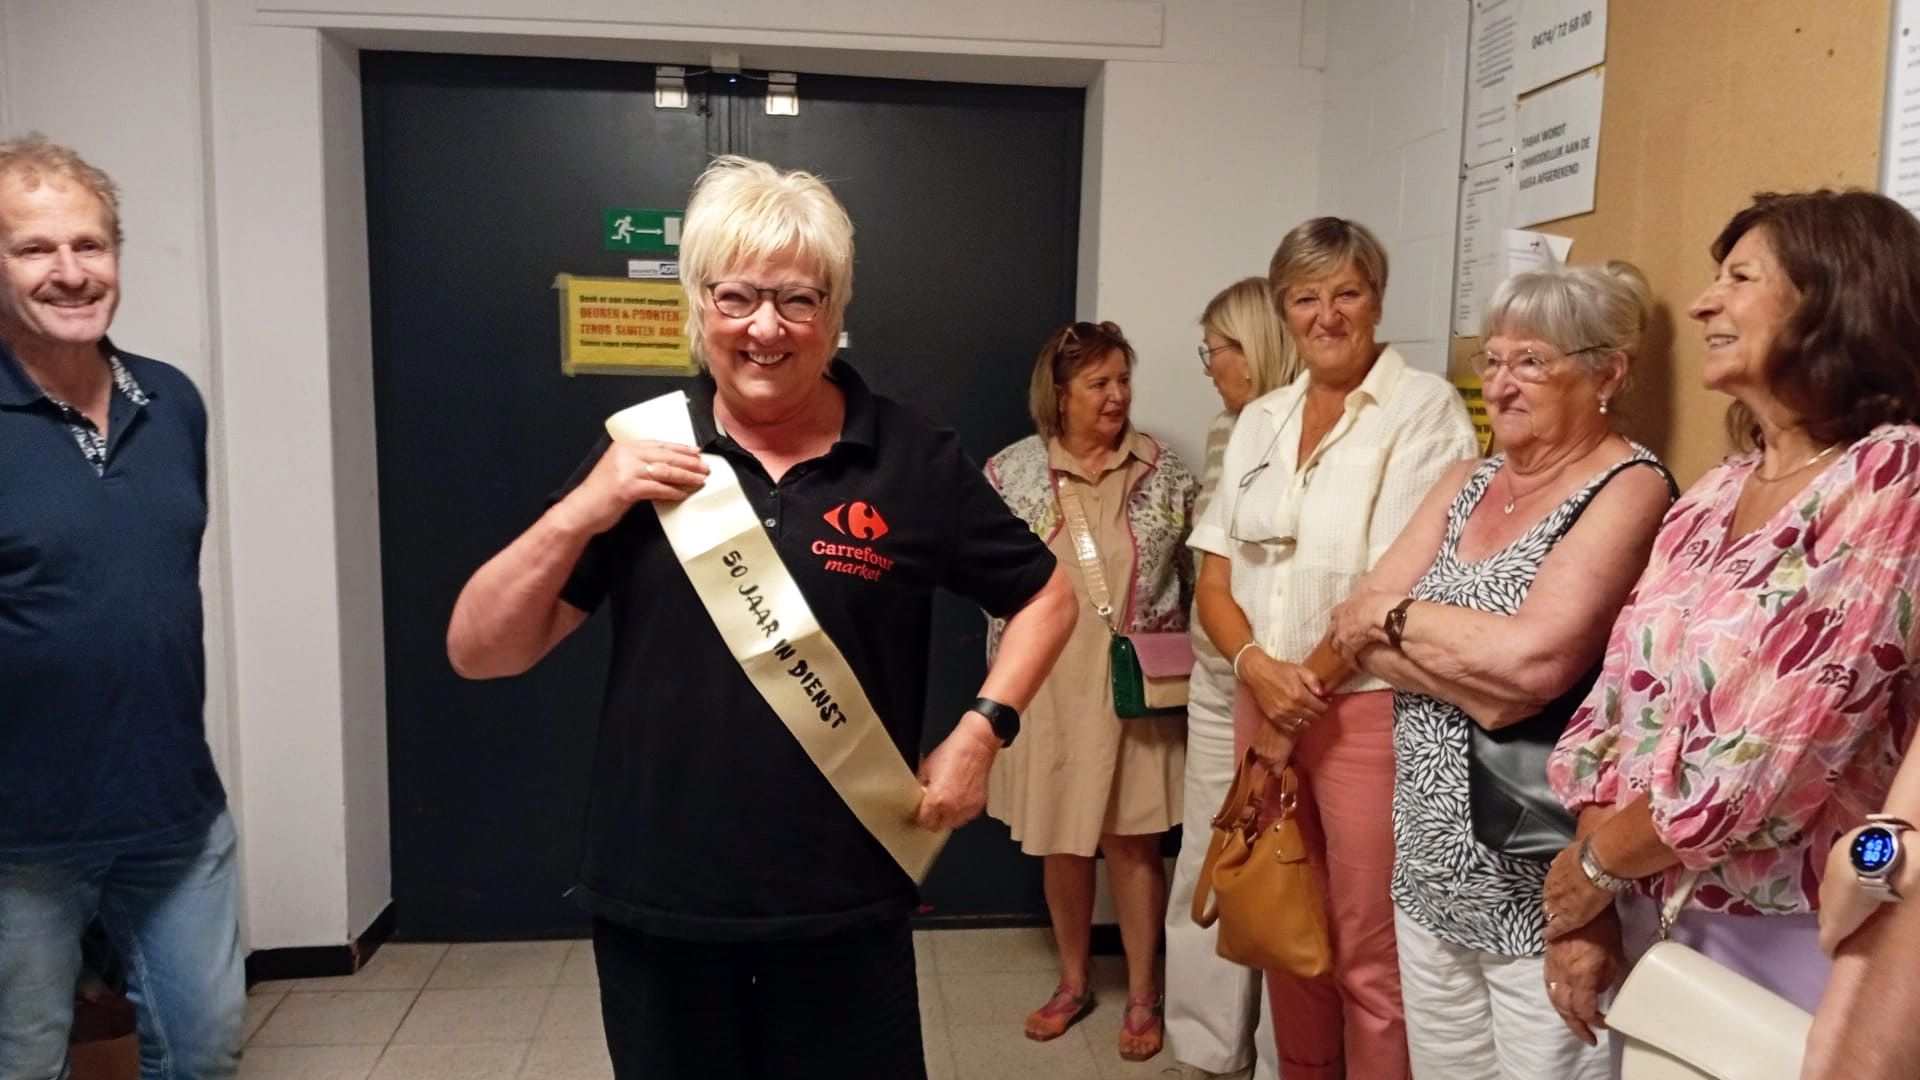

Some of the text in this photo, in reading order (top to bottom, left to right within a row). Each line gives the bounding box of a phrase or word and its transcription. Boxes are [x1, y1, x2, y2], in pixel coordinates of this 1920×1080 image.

[580, 307, 620, 319] DEUREN
[631, 308, 679, 321] POORTEN
[580, 324, 611, 335] TERUG
[811, 540, 895, 571] Carrefour
[824, 560, 882, 581] market
[722, 550, 847, 729] 50 JAAR IN DIENST
